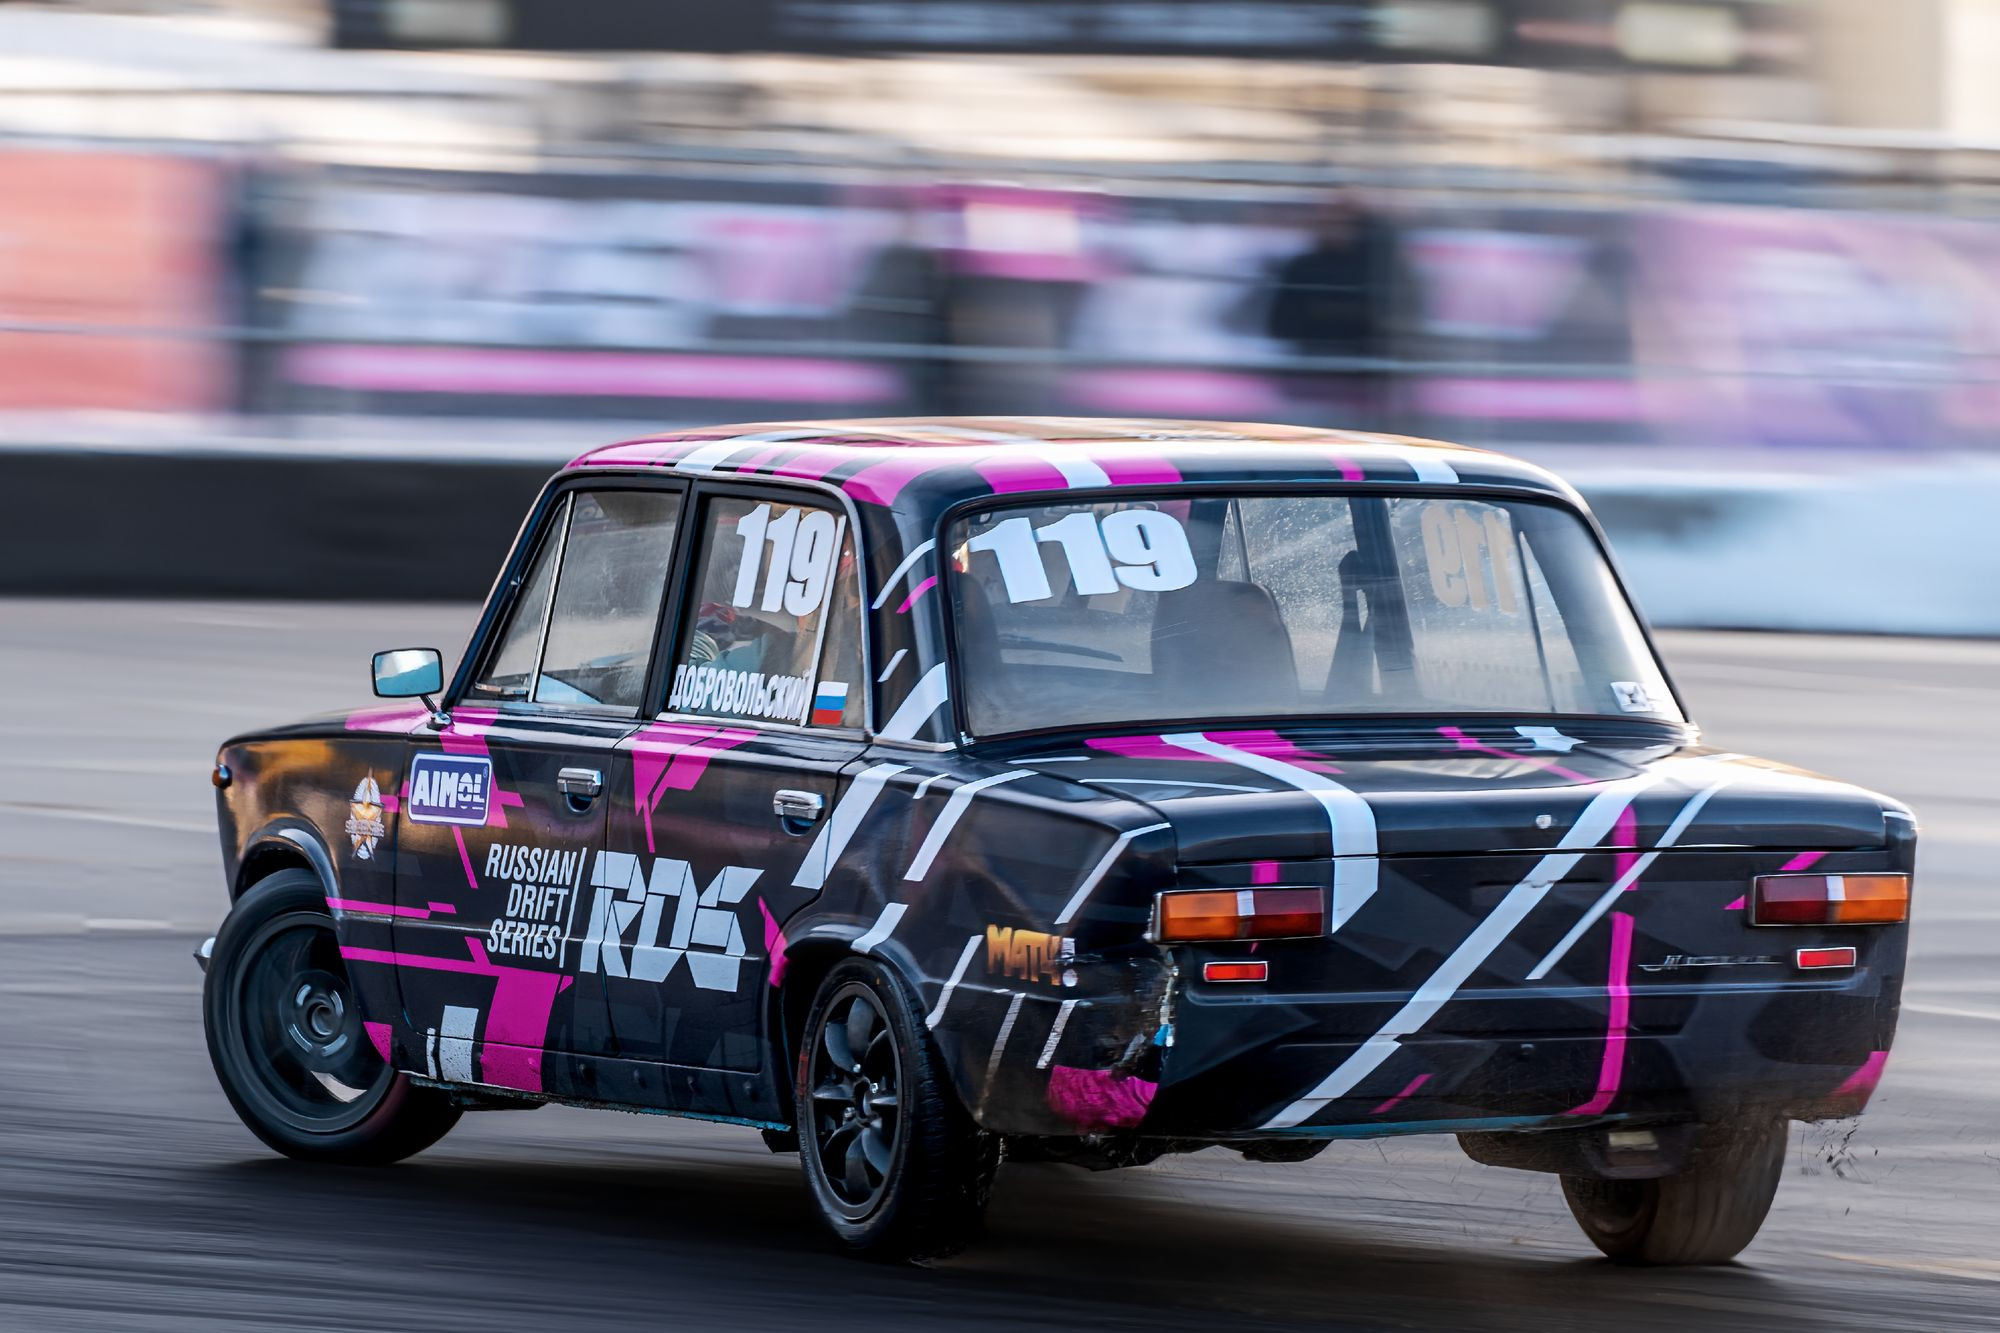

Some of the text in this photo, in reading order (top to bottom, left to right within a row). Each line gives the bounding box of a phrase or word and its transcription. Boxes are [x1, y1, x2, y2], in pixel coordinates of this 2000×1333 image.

[732, 503, 836, 617] 119
[967, 509, 1198, 604] 119
[668, 664, 811, 720] ДОБРОВОЛЬСКИЙ
[412, 769, 485, 810] AIMOL
[485, 843, 577, 885] RUSSIAN
[506, 883, 569, 922] DRIFT
[580, 850, 765, 992] RDS
[487, 918, 561, 960] SERIES
